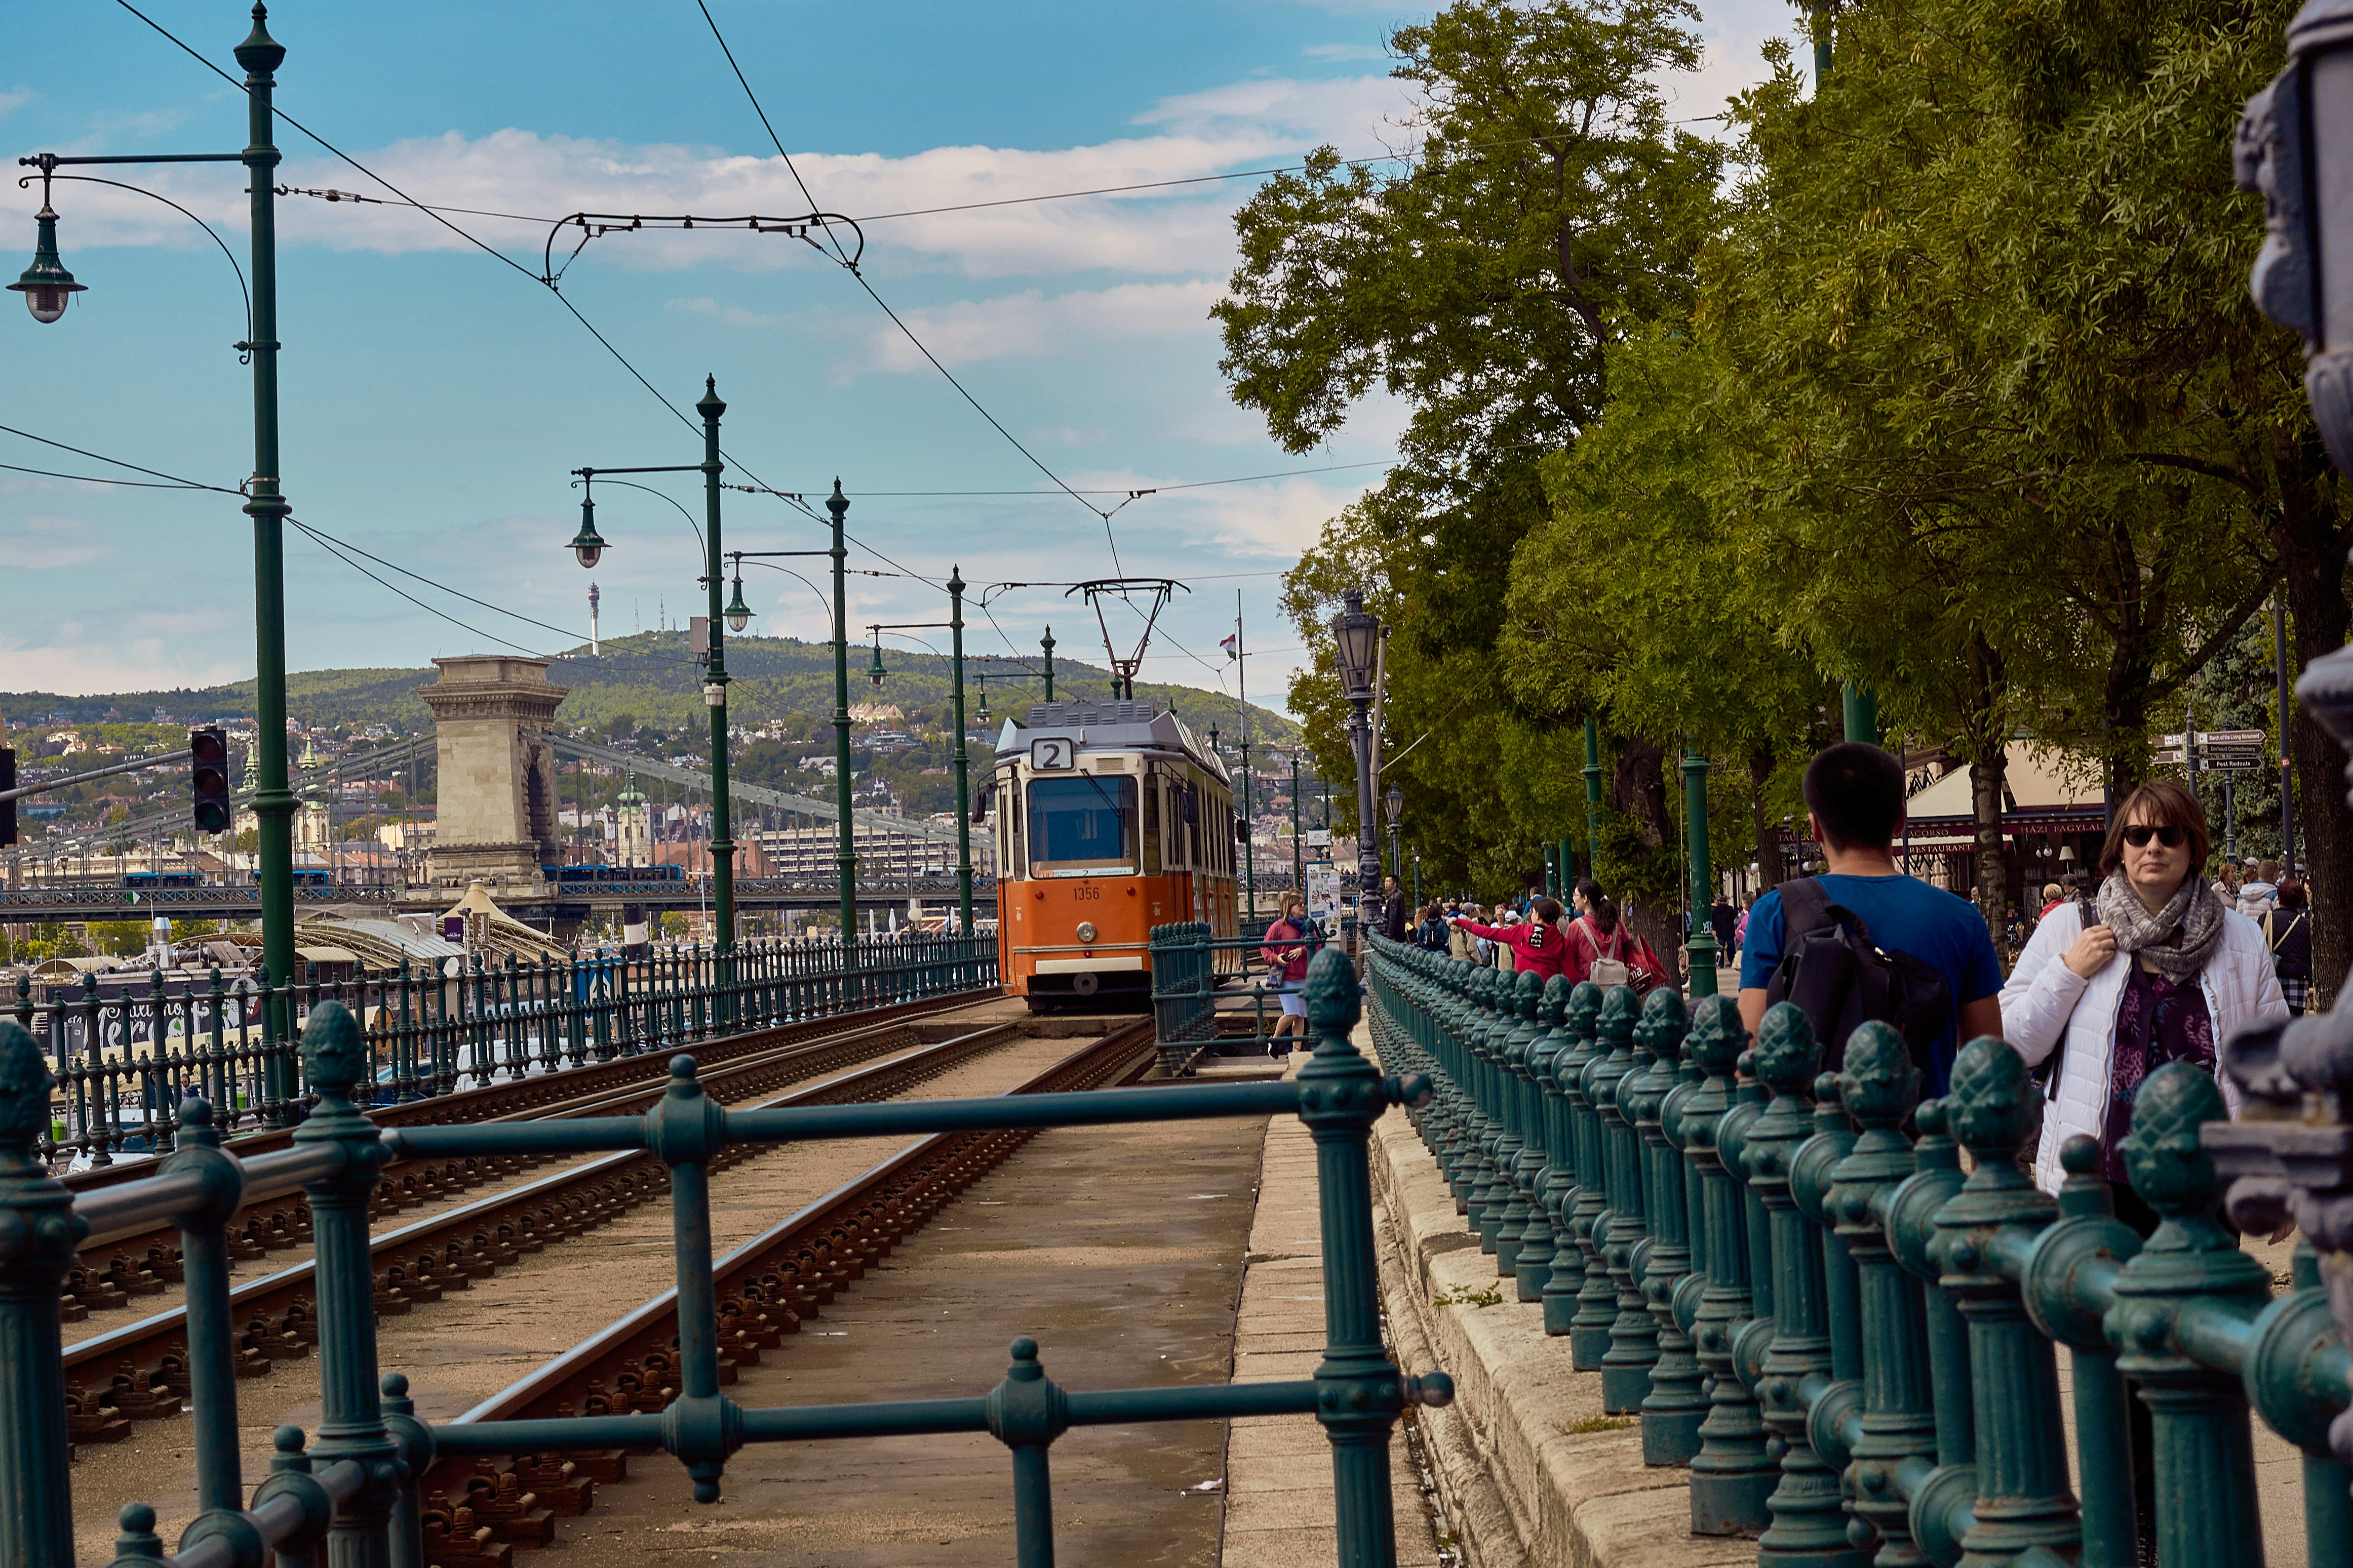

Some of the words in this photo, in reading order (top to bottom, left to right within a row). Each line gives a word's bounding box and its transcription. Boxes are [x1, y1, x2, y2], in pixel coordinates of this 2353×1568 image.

[1043, 744, 1060, 768] 2
[2021, 824, 2047, 833] HÁZI
[1910, 844, 1972, 853] RESTAURANT
[1074, 887, 1099, 900] 1356
